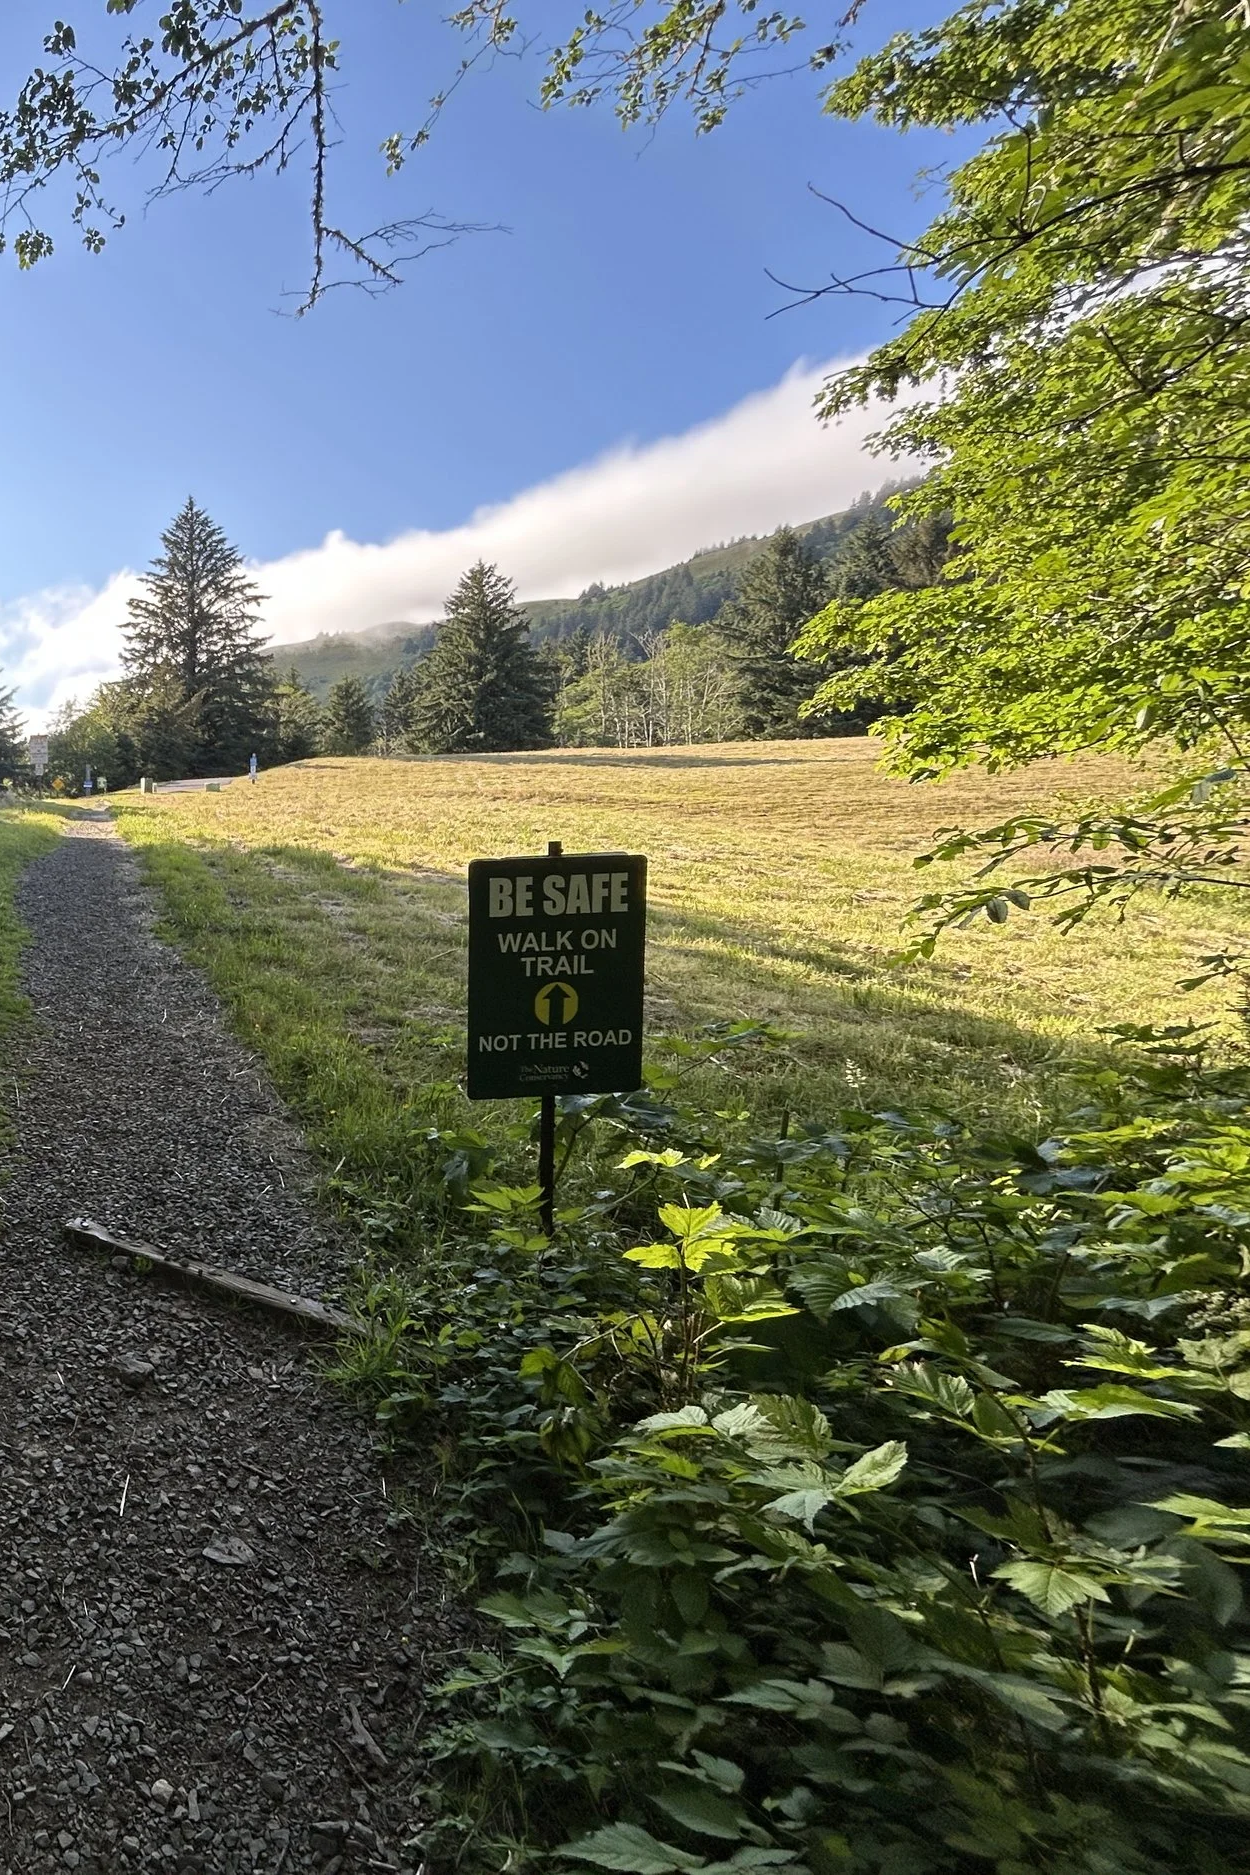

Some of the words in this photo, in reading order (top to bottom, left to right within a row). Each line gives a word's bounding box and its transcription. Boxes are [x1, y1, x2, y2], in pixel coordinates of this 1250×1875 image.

[489, 876, 534, 918] BE
[542, 872, 629, 916] SAFE
[498, 930, 574, 953] WALK
[580, 928, 617, 950] ON
[521, 955, 595, 977] TRAIL
[479, 1034, 521, 1052] NOT
[527, 1032, 567, 1050] THE
[573, 1029, 632, 1047] ROAD
[533, 1064, 570, 1074] Nature
